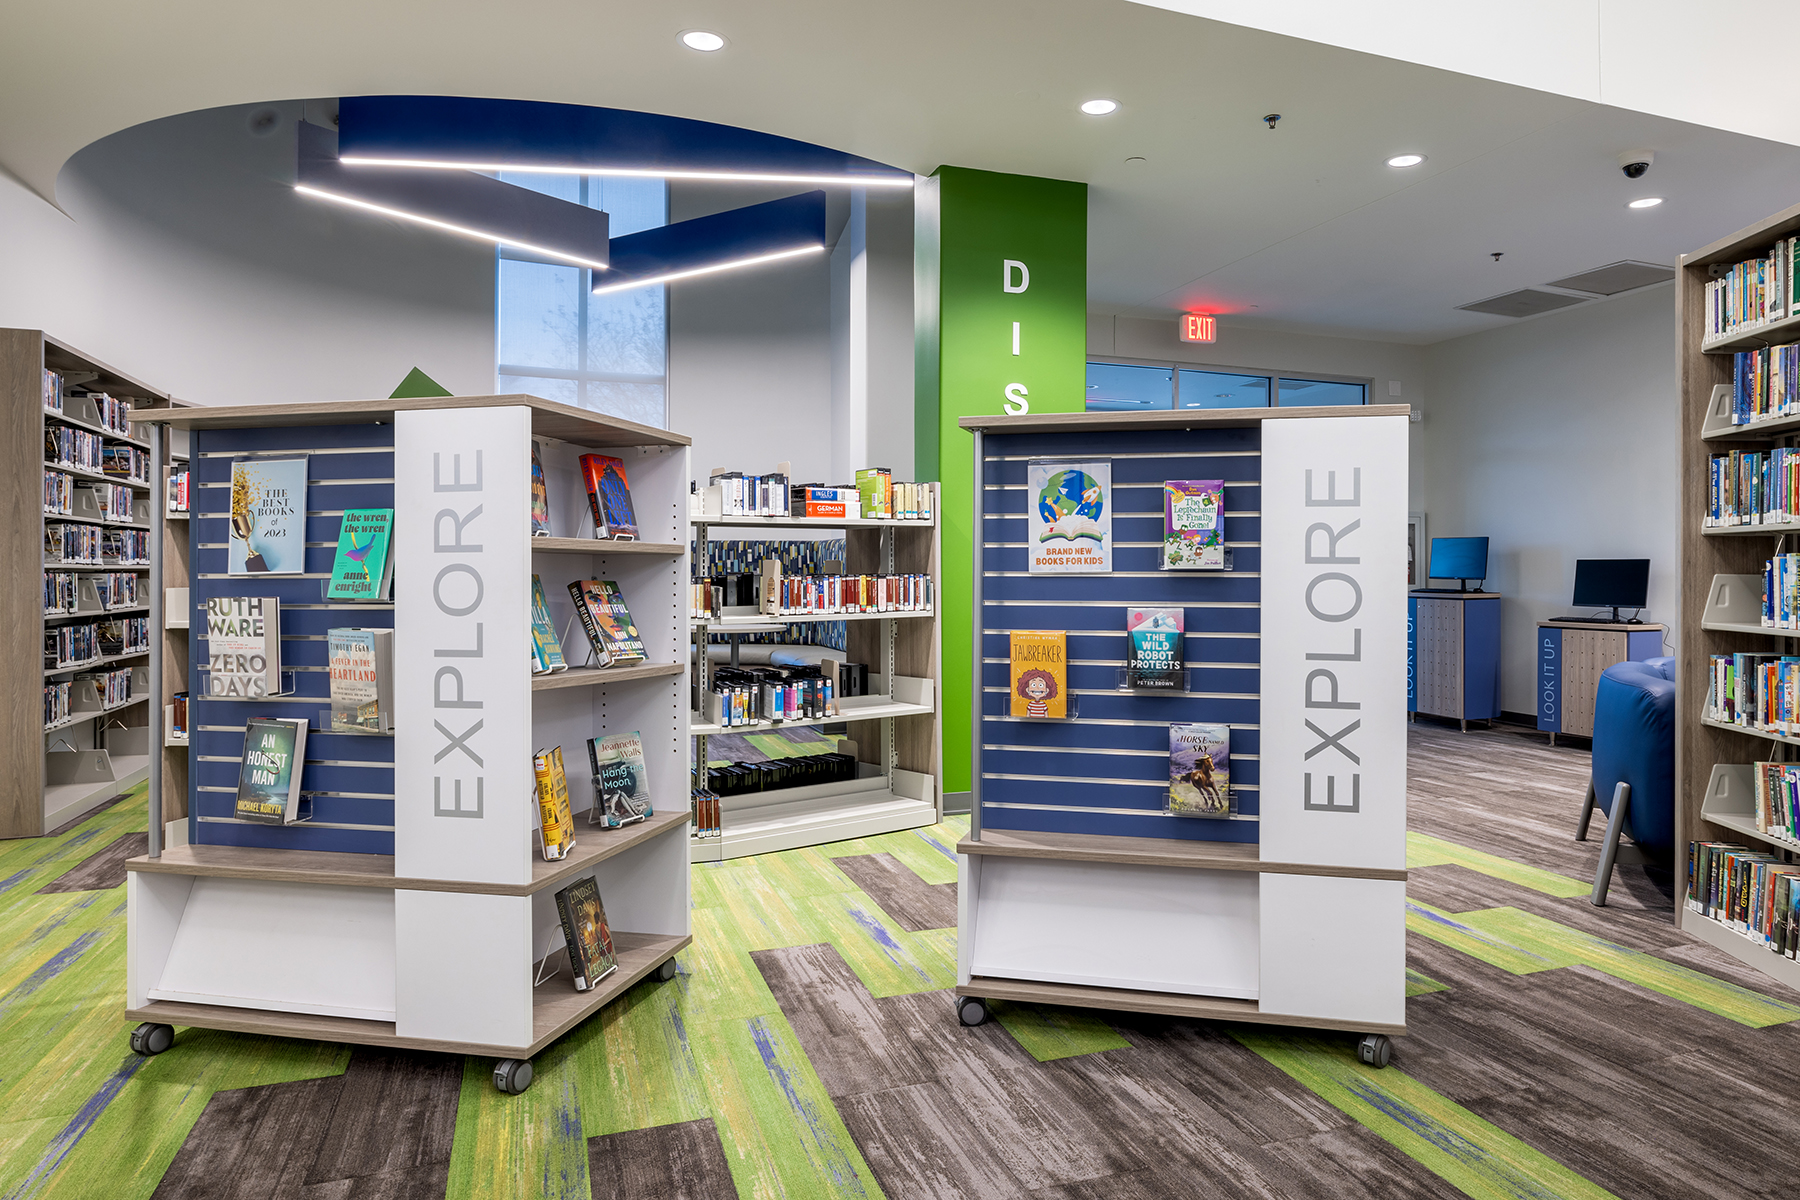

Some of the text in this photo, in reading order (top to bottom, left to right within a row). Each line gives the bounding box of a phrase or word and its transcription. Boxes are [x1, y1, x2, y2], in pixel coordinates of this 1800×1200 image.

[1188, 316, 1213, 340] EXIT
[265, 488, 288, 498] THE
[601, 479, 626, 496] ONLY
[262, 498, 290, 508] BEST
[607, 495, 628, 510] ONE
[1185, 497, 1200, 506] The
[258, 507, 295, 517] BOOKS
[1174, 505, 1216, 515] Leprechaun
[270, 518, 278, 527] of
[346, 513, 389, 523] the wren,
[608, 510, 632, 526] LEFT
[1186, 514, 1212, 523] Finally
[264, 529, 287, 538] 2023
[344, 524, 385, 533] the wren
[1046, 548, 1073, 556] BRAND
[1036, 557, 1104, 566] BOOKS FOR KIDS
[343, 572, 368, 580] anne
[335, 582, 372, 594] enright
[590, 585, 613, 595] HELLO
[208, 598, 262, 617] RUTH
[571, 587, 597, 638] HELLO BEAUTIFUL
[590, 604, 628, 614] BEAUTIFUL
[208, 619, 264, 637] WARE
[433, 450, 484, 819] EXPLORE
[1304, 466, 1361, 812] EXPLORE
[330, 643, 370, 653] TIMOTHY EGAN
[1142, 642, 1170, 651] WILD
[1013, 644, 1062, 663] JAWBREAKER
[1138, 651, 1174, 660] ROBOT
[210, 654, 266, 673] ZERO
[335, 658, 351, 666] FEVER
[360, 659, 370, 667] THE
[1131, 660, 1180, 670] PROTECTS
[330, 668, 376, 682] HEARTLAND
[1544, 638, 1555, 722] LOOK IT UP
[211, 676, 266, 696] DAYS
[261, 733, 275, 748] AN
[601, 739, 640, 752] Jeannette
[1180, 735, 1208, 745] HORSE
[620, 749, 641, 758] Walls
[1193, 745, 1209, 753] SKY
[247, 750, 288, 768] HONEST
[602, 764, 643, 779] Hang the
[252, 770, 275, 786] MAN
[604, 778, 630, 790] Moon
[237, 800, 259, 812] MICHAEL
[569, 881, 596, 904] LINDSEY
[577, 897, 596, 916] DAVIS
[587, 938, 607, 959] FATAL
[587, 952, 615, 978] LEGACY
